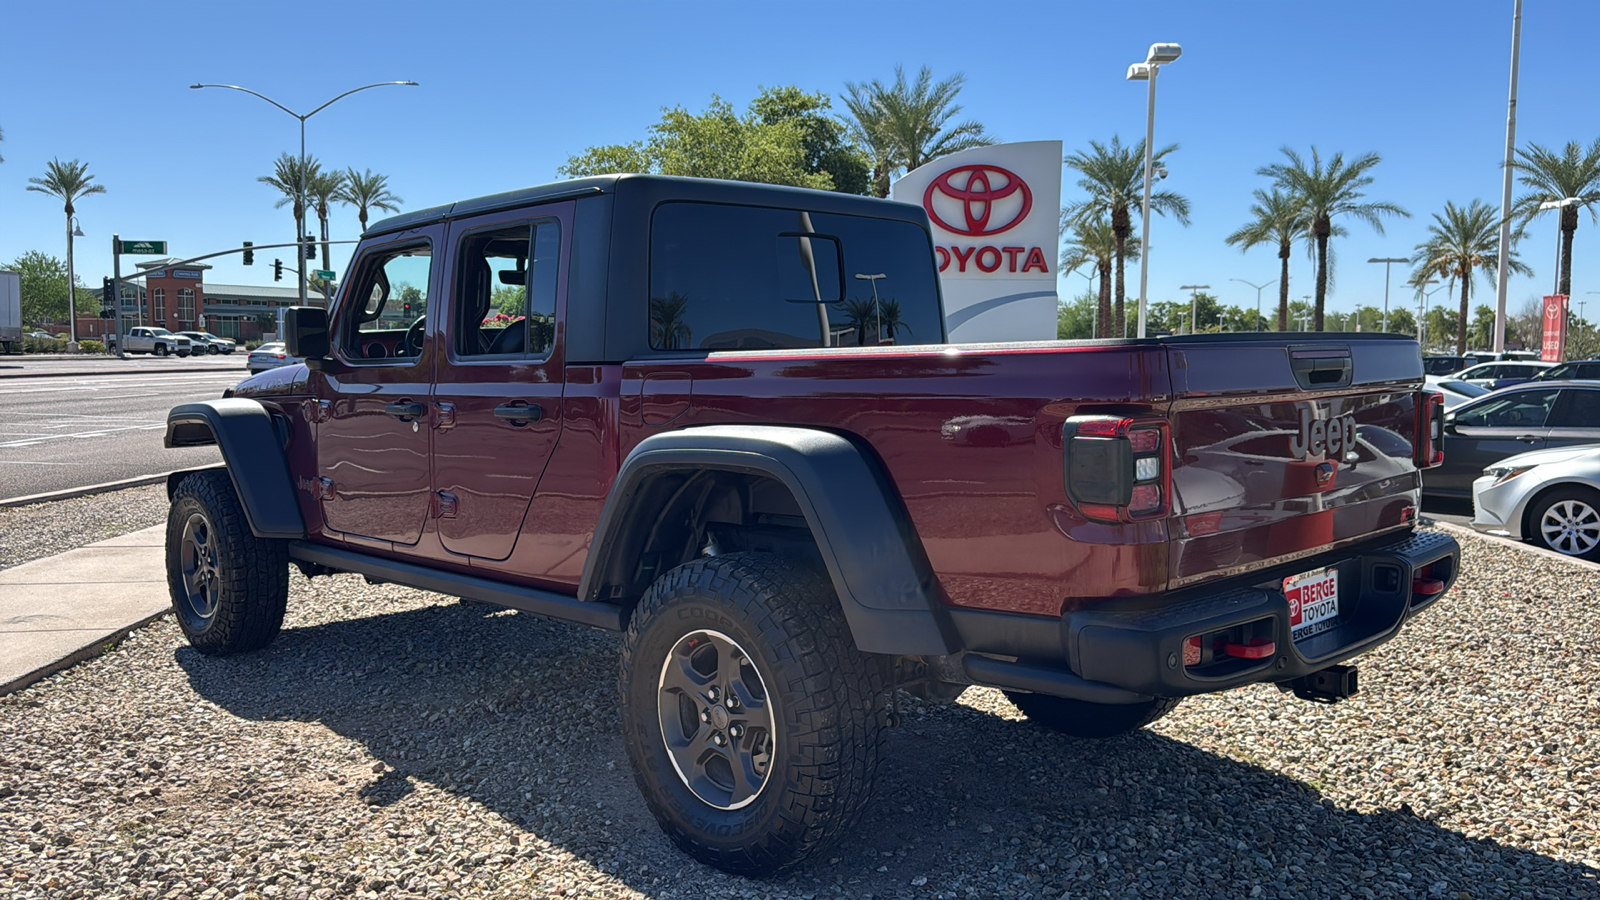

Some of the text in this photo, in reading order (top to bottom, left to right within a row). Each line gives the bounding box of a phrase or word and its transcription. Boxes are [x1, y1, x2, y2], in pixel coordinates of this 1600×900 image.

[935, 245, 1049, 273] OYOTA
[1542, 340, 1559, 350] USED
[1289, 408, 1356, 461] Jeep
[1303, 578, 1335, 605] BERGE
[1303, 600, 1336, 622] TOYOTA
[1293, 625, 1313, 640] ERGE
